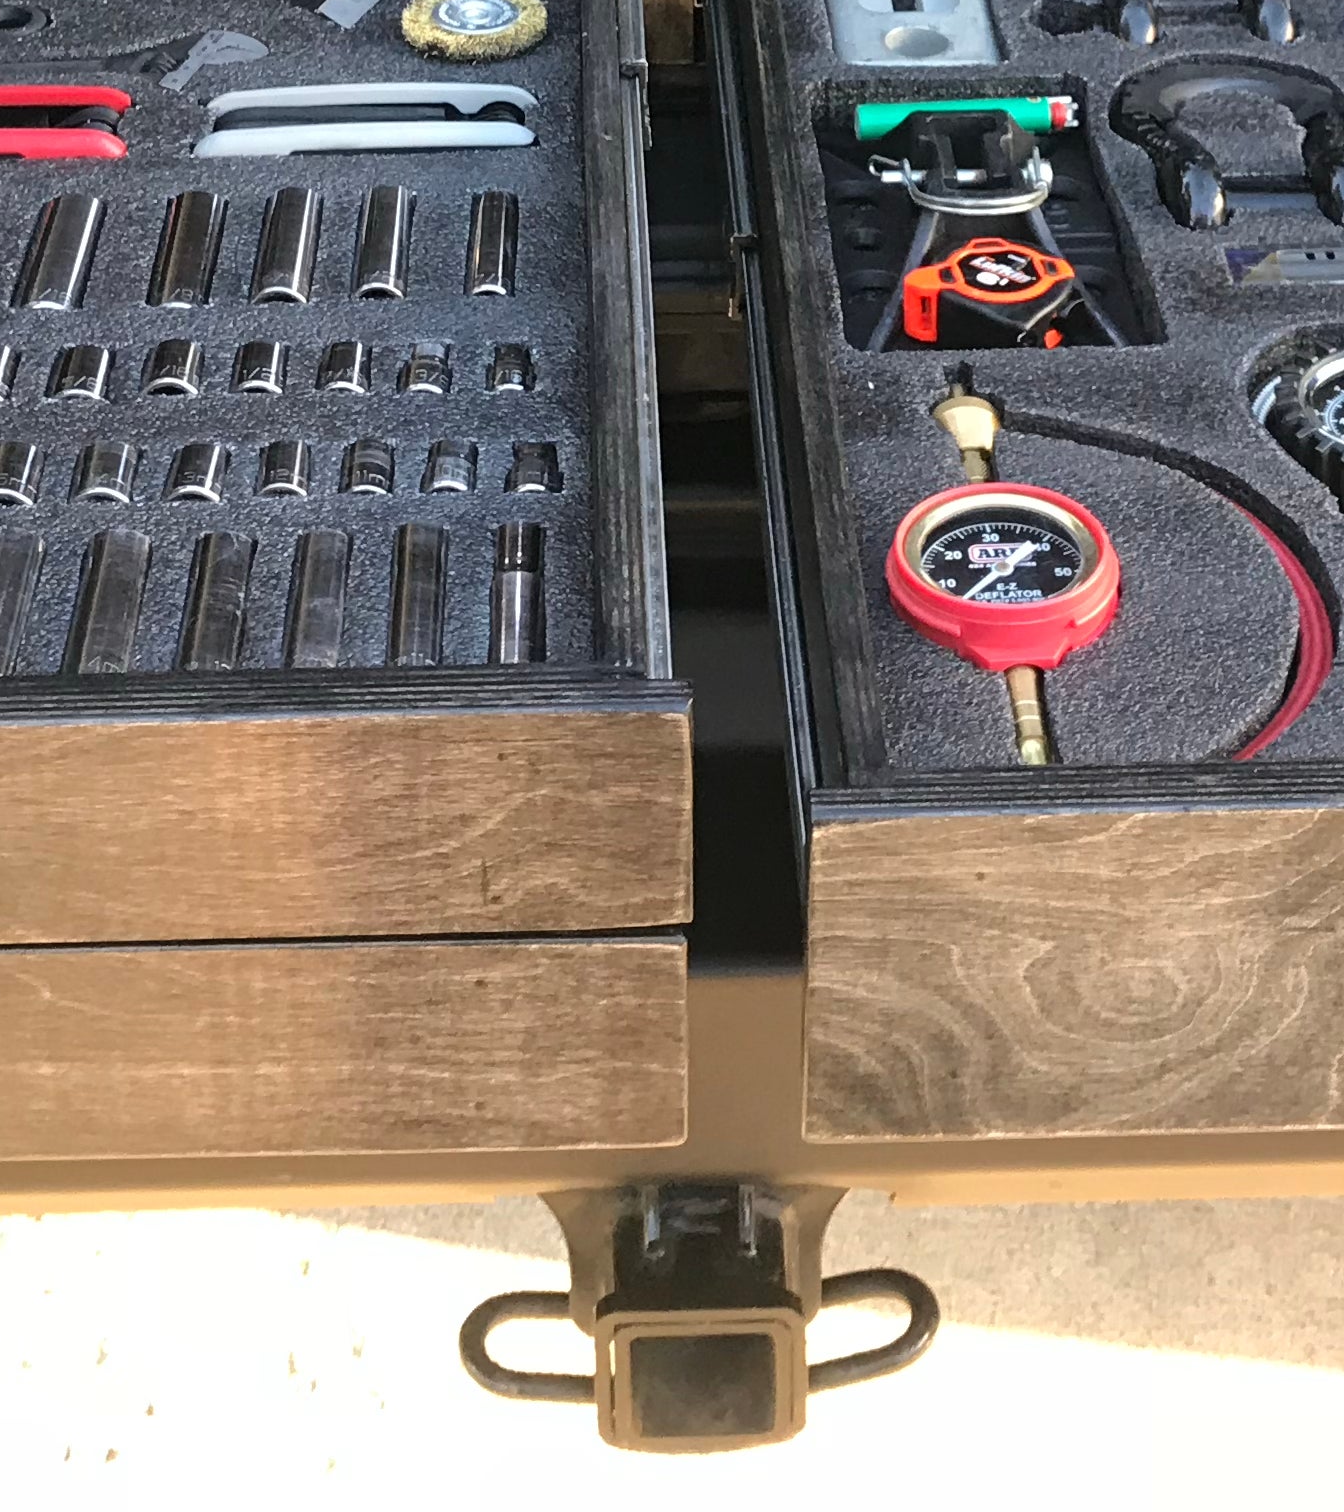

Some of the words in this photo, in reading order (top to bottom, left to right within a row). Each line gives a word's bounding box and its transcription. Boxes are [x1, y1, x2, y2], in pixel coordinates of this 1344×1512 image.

[981, 533, 1001, 543] 30
[943, 550, 964, 561] 20
[1053, 567, 1073, 577] 50
[938, 579, 958, 589] 10
[974, 589, 1044, 601] DEFLATOR
